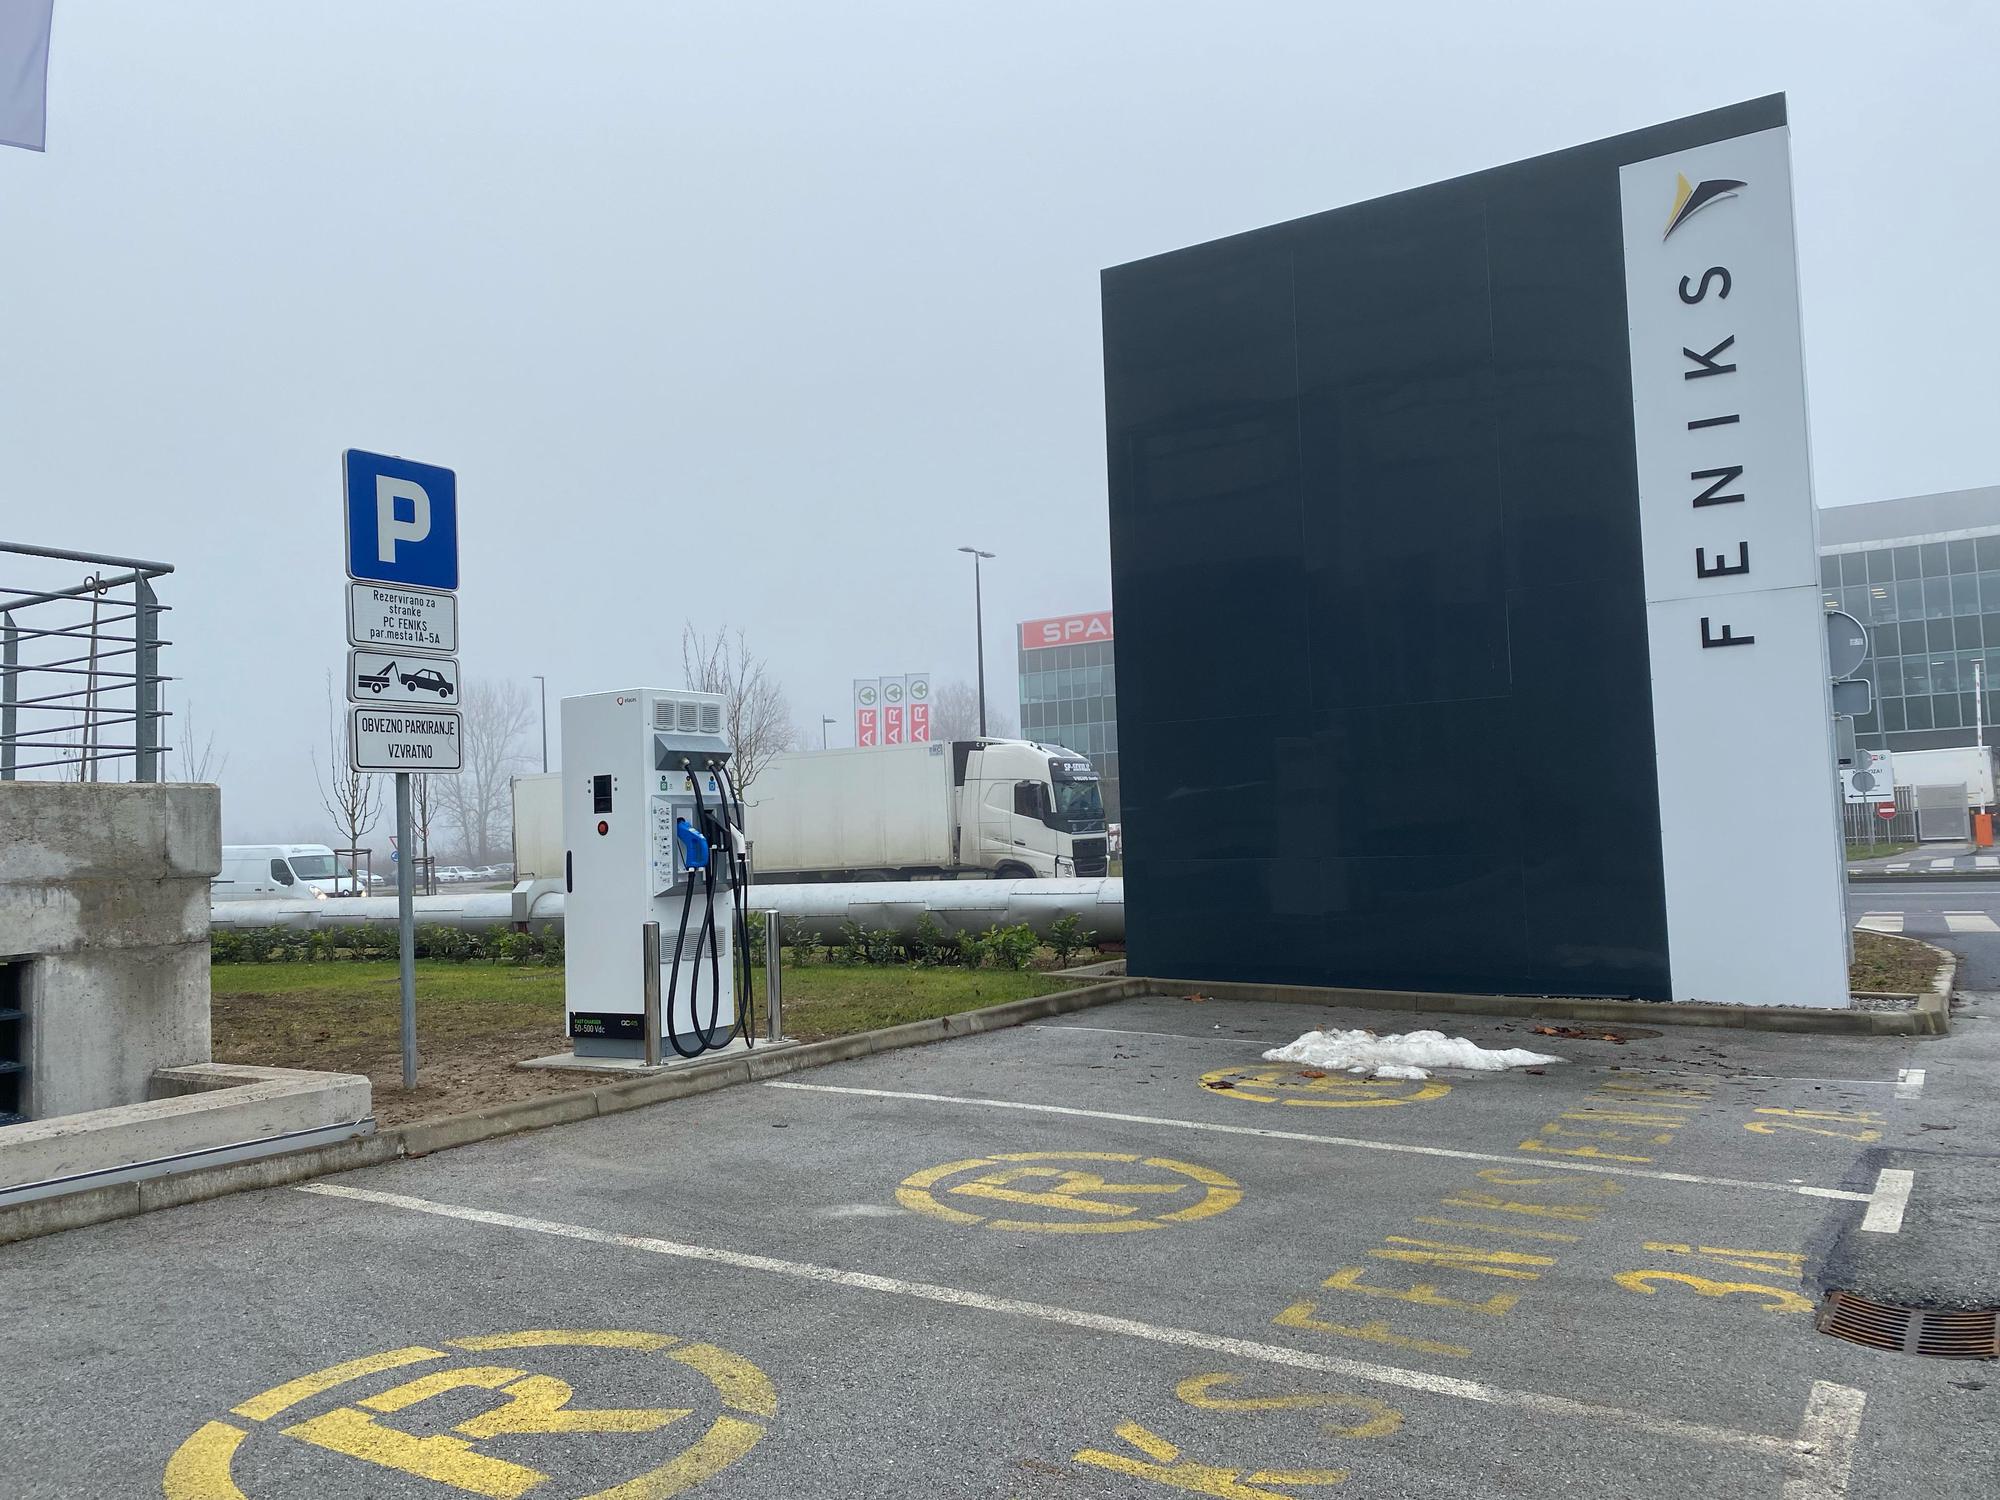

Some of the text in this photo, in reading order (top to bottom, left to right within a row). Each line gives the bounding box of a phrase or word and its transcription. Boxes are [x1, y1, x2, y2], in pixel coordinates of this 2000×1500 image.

[1678, 265, 1755, 649] FENIKS
[375, 474, 431, 563] P
[373, 589, 436, 608] Rezervirano za
[389, 604, 422, 617] stranke
[383, 616, 428, 632] PC FENIKS
[1043, 617, 1113, 642] SPA
[362, 717, 455, 736] OBVEZNO PARKIRANJE
[388, 743, 433, 759] VZVRATNO
[574, 1023, 594, 1033] 50-500
